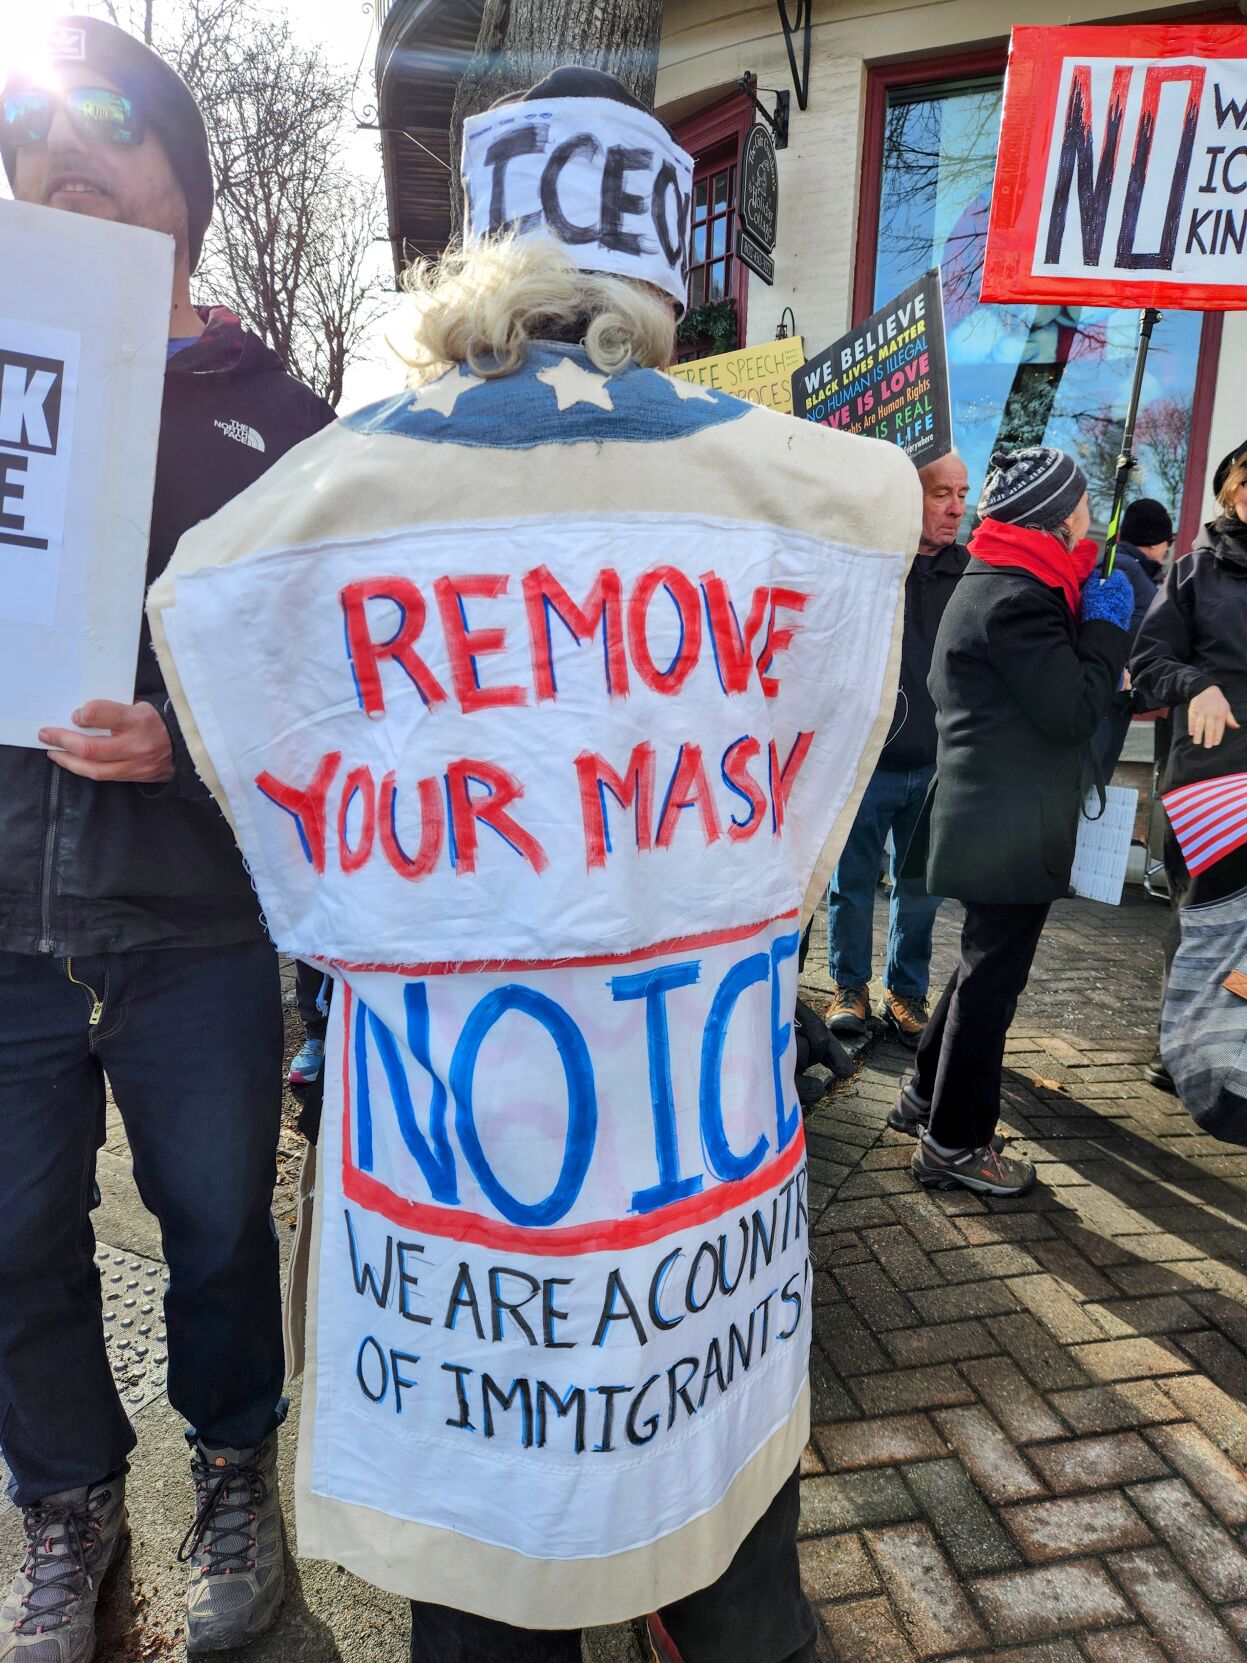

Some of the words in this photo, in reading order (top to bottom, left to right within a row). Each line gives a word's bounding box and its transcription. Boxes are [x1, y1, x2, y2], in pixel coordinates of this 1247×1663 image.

[1043, 64, 1207, 271] NO
[726, 352, 786, 386] SPEECH
[804, 360, 833, 394] WE
[840, 292, 926, 371] BELIEVE
[805, 378, 839, 410] BLACK
[842, 355, 874, 386] LIVES
[878, 320, 926, 362] MATTER
[806, 404, 824, 422] NO
[827, 373, 870, 413] HUMAN
[873, 365, 883, 382] IS
[886, 335, 928, 374] ILLEGAL
[857, 389, 874, 416] IS
[881, 352, 930, 401] LOVE
[863, 414, 876, 429] Are
[877, 395, 904, 420] Human
[906, 378, 931, 402] Rights
[875, 421, 888, 439] IS
[895, 395, 933, 429] REAL
[213, 419, 249, 440] NORTH
[224, 429, 248, 445] FACE
[230, 419, 249, 431] THE
[896, 413, 934, 447] LIFE
[340, 563, 811, 719] REMOVE
[254, 751, 550, 882] YOUR
[356, 981, 598, 1226] NO
[344, 1209, 433, 1325] WE
[444, 1261, 579, 1349] ARE
[591, 1267, 648, 1348] A
[647, 1161, 808, 1331] COUNTR
[355, 1334, 420, 1413] OF
